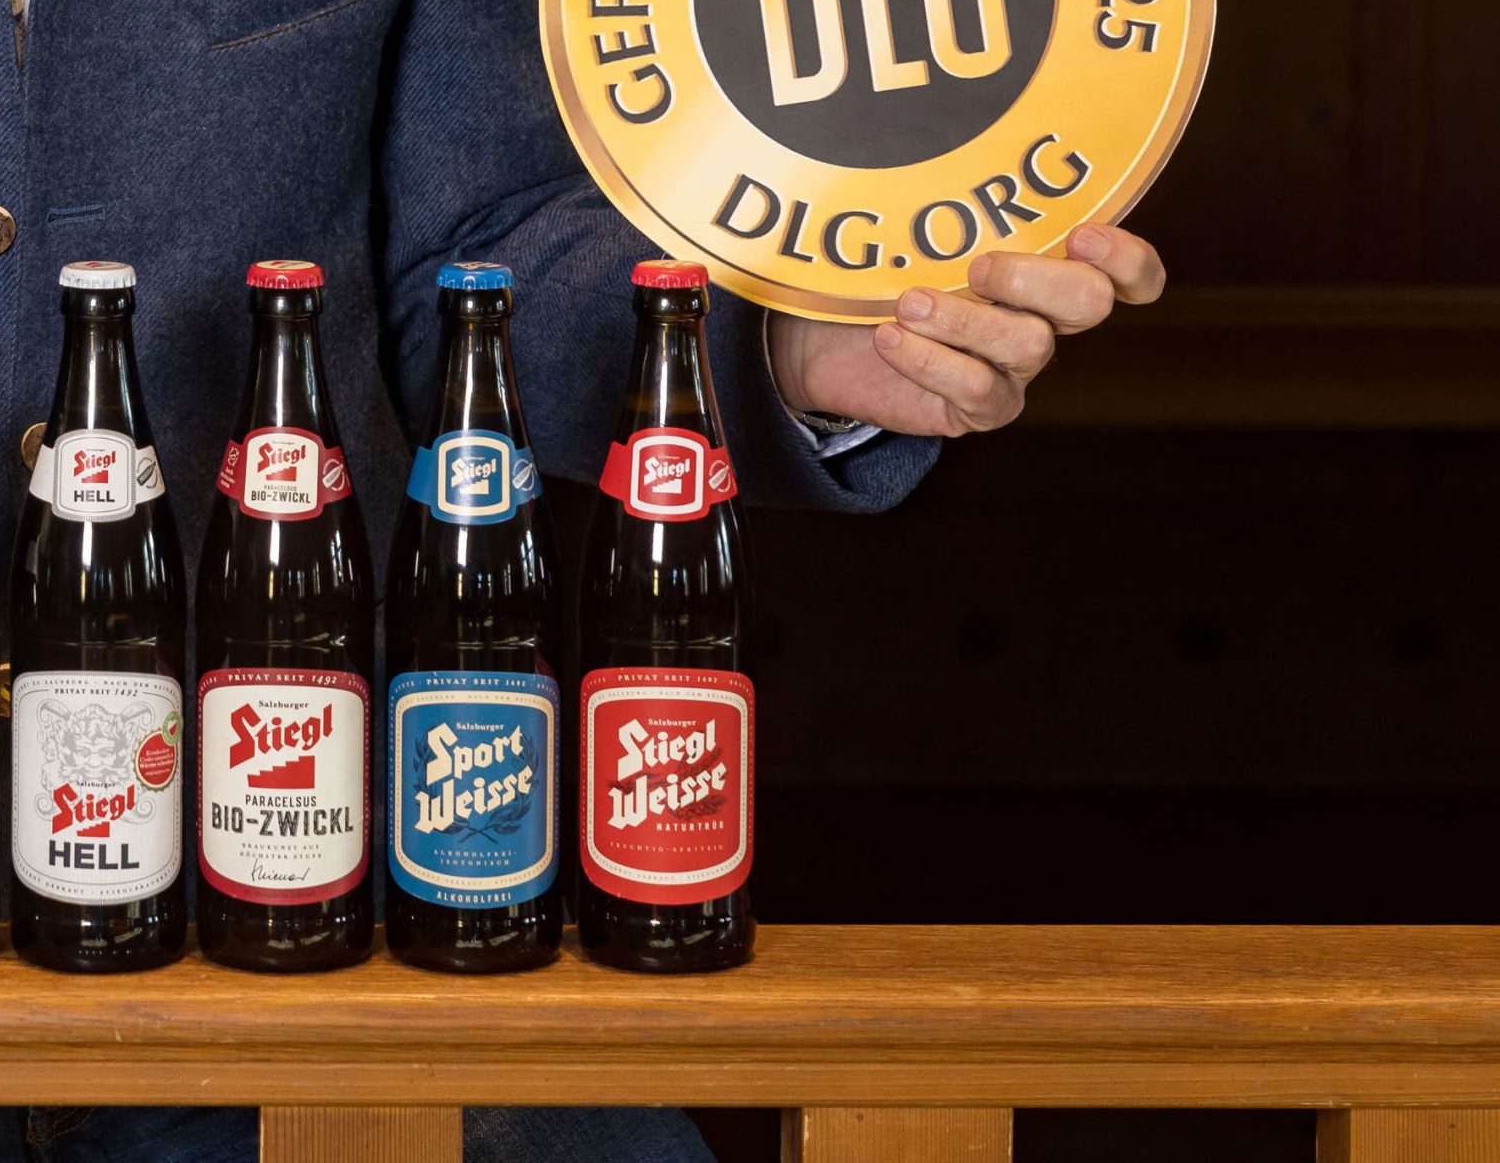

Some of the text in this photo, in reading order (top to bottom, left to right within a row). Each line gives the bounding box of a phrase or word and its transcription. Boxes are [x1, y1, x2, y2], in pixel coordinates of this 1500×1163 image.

[712, 134, 1091, 271] DLG.ORG
[73, 450, 116, 477] Stiegl
[257, 442, 306, 473] Stiegl
[643, 456, 690, 486] Stiegl
[451, 458, 497, 488] Stiegl
[74, 490, 115, 502] HELL
[251, 491, 311, 504] BIO-ZWICKL
[228, 674, 337, 685] PRIVAT SEIT 1492
[618, 674, 658, 682] PRIVAT
[114, 688, 138, 697] 1492
[258, 700, 309, 710] Salzburger
[229, 703, 333, 769] Stiegl
[456, 722, 505, 732] Salzburger
[648, 718, 697, 728] Salzburger
[427, 722, 523, 785] Sport
[617, 718, 716, 782] Stiegl
[52, 782, 135, 834] Stiegl
[245, 794, 317, 808] PARACELSUS
[414, 765, 533, 834] Weisse
[608, 762, 727, 830] Weisse
[211, 802, 354, 837] BIO-ZWICKL
[656, 820, 724, 832] NATURTRÜB
[49, 839, 140, 870] HELL
[436, 891, 512, 903] ALKOHOLFREI
